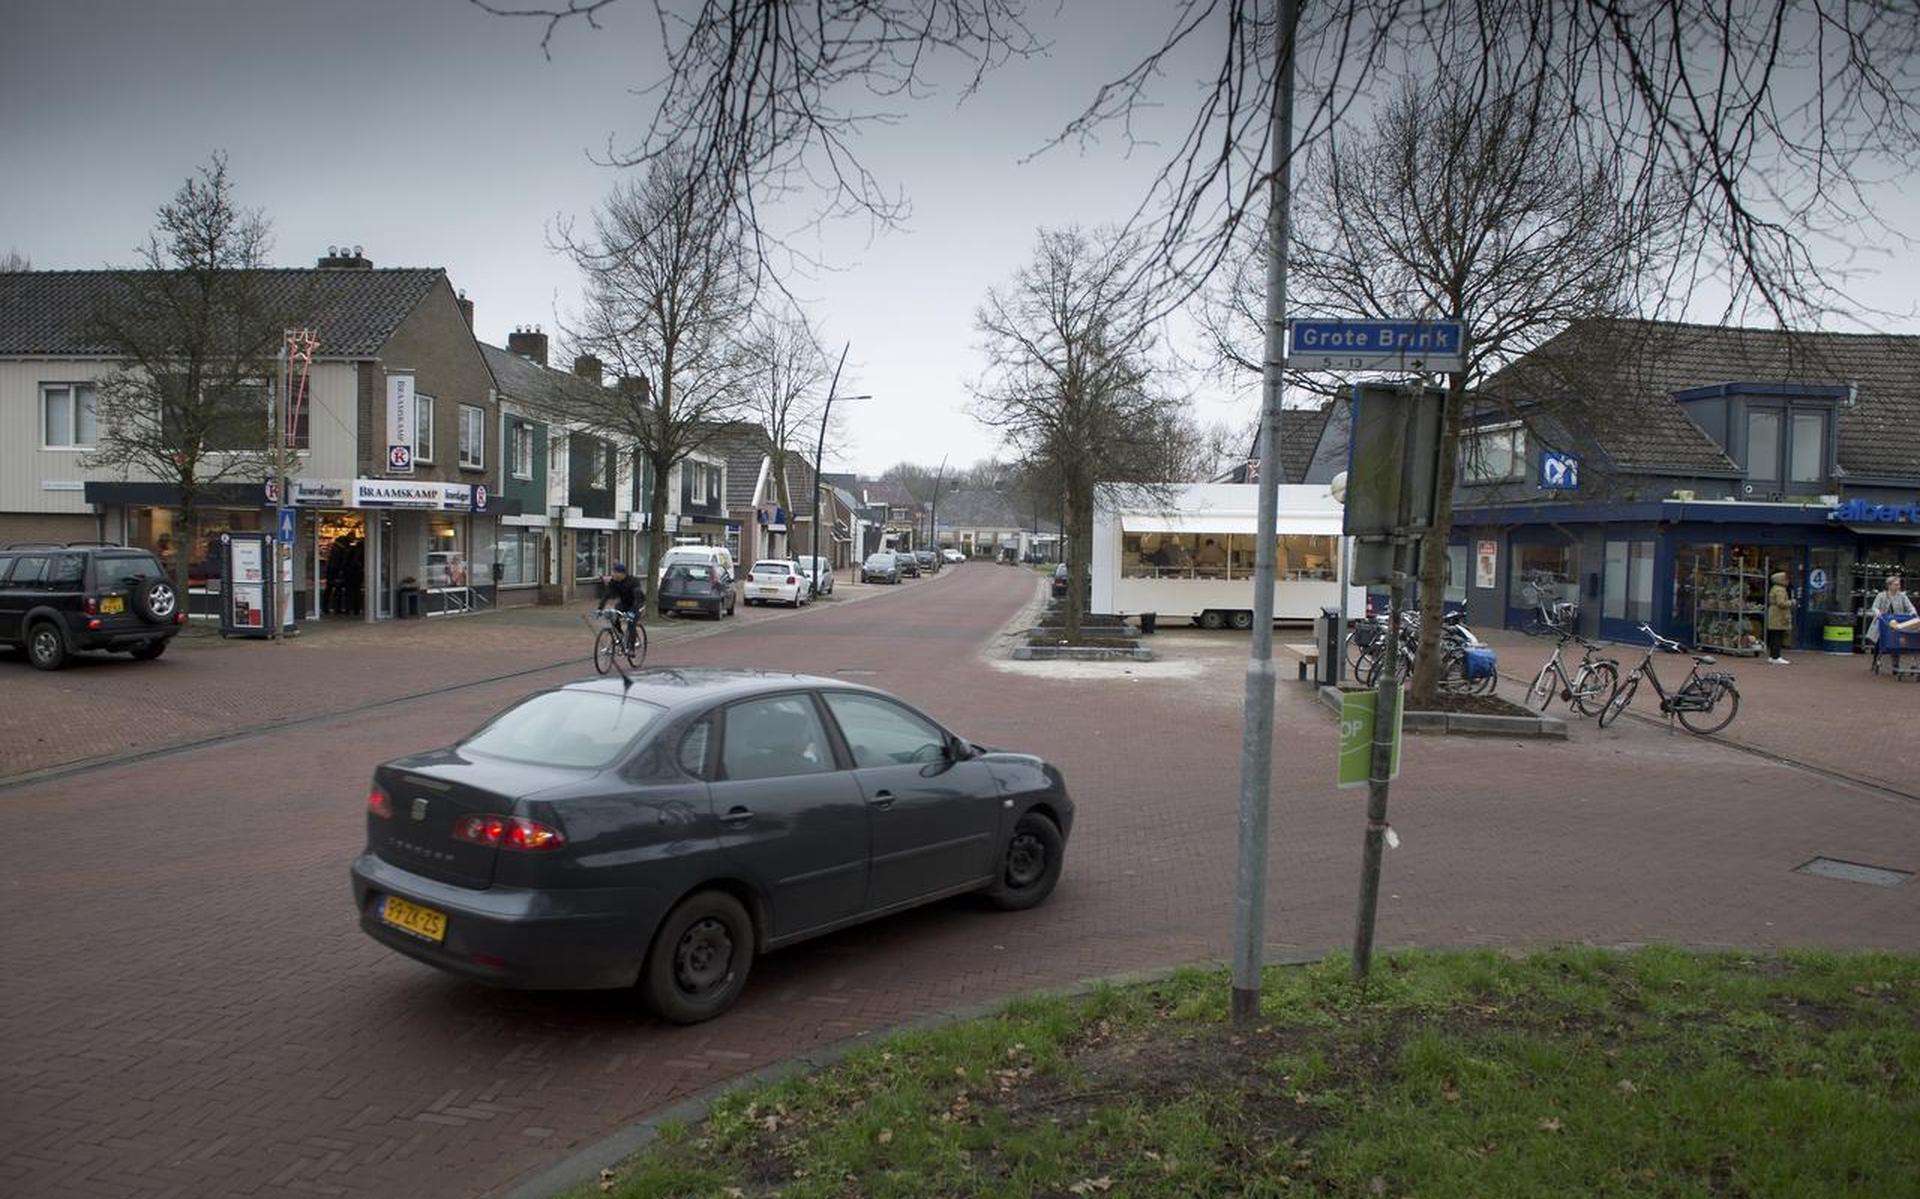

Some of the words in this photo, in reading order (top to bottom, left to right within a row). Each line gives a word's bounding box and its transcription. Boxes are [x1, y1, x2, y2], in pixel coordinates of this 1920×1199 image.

[1303, 328, 1368, 346] Grote
[1378, 328, 1449, 347] Brink
[359, 485, 438, 499] BRAAMSKAMP
